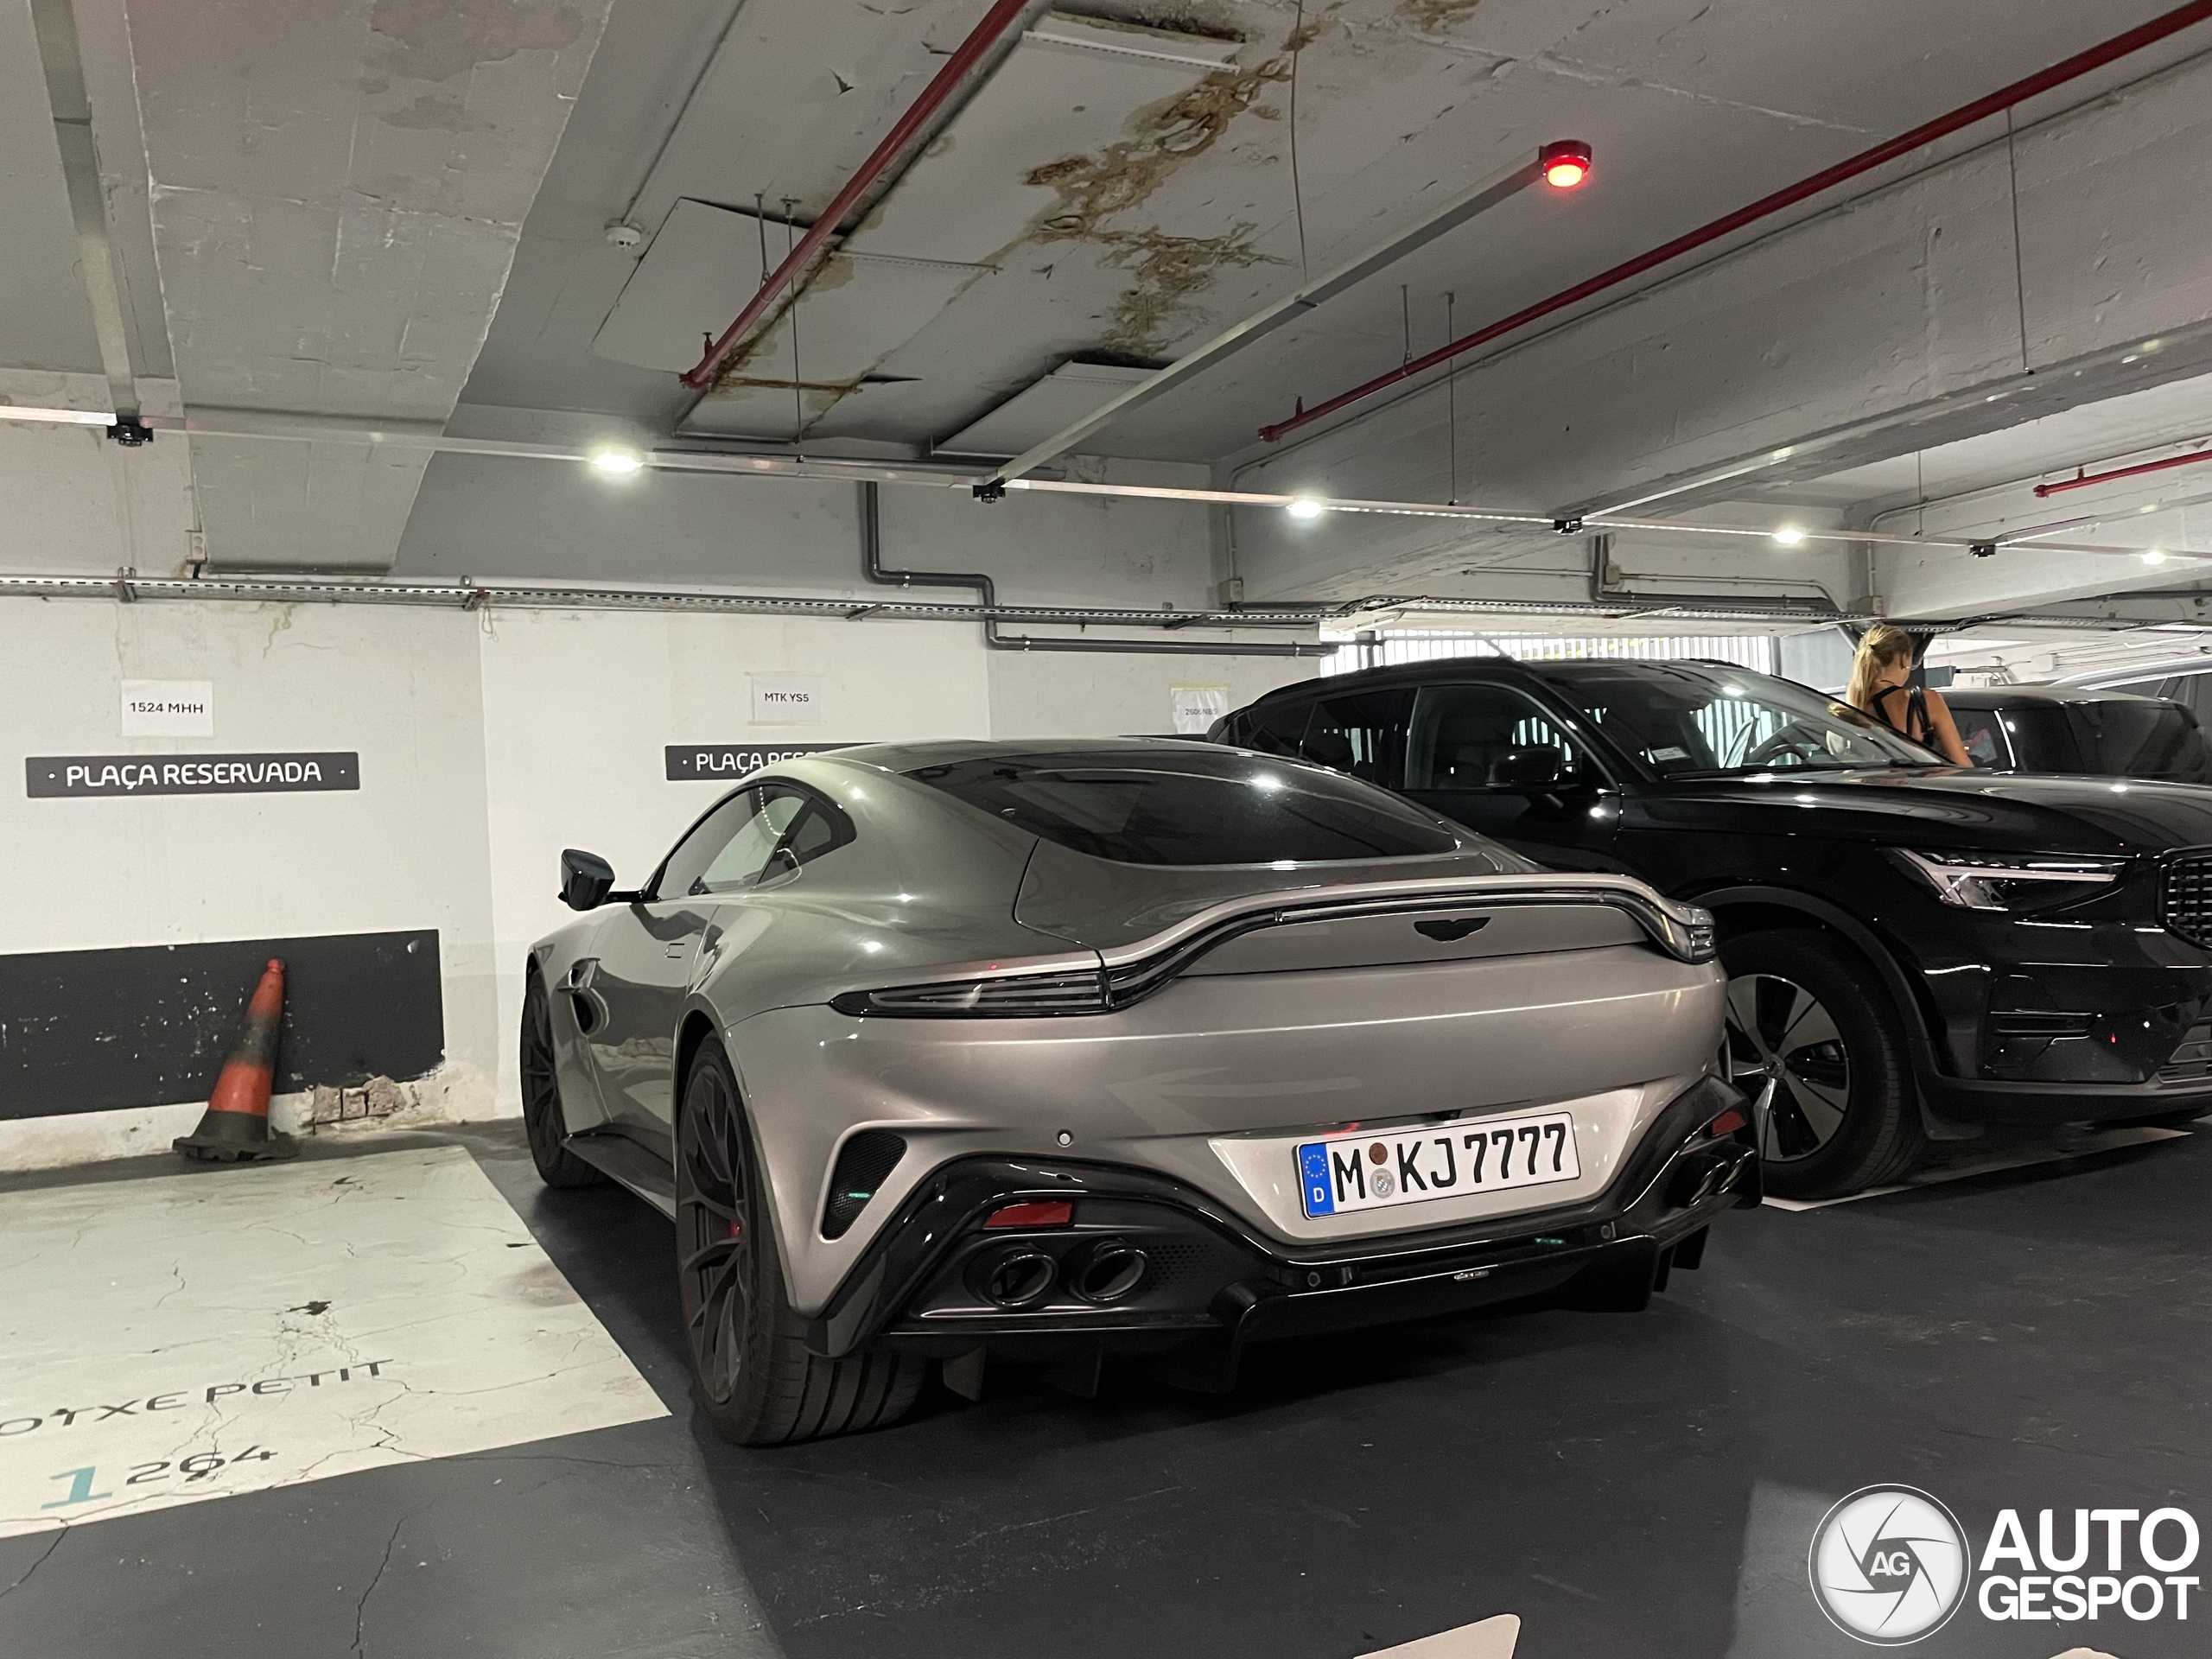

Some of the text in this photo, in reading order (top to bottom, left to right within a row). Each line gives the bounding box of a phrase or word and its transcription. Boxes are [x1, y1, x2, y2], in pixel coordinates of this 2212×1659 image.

[130, 702, 204, 714] 1524 MHH
[764, 692, 787, 702] MTK
[696, 752, 764, 774] PLAÇA
[67, 761, 322, 790] PLAÇA RESERVADA
[1332, 1148, 1366, 1202] M
[1313, 1187, 1325, 1204] D
[205, 1359, 394, 1403] PETIT
